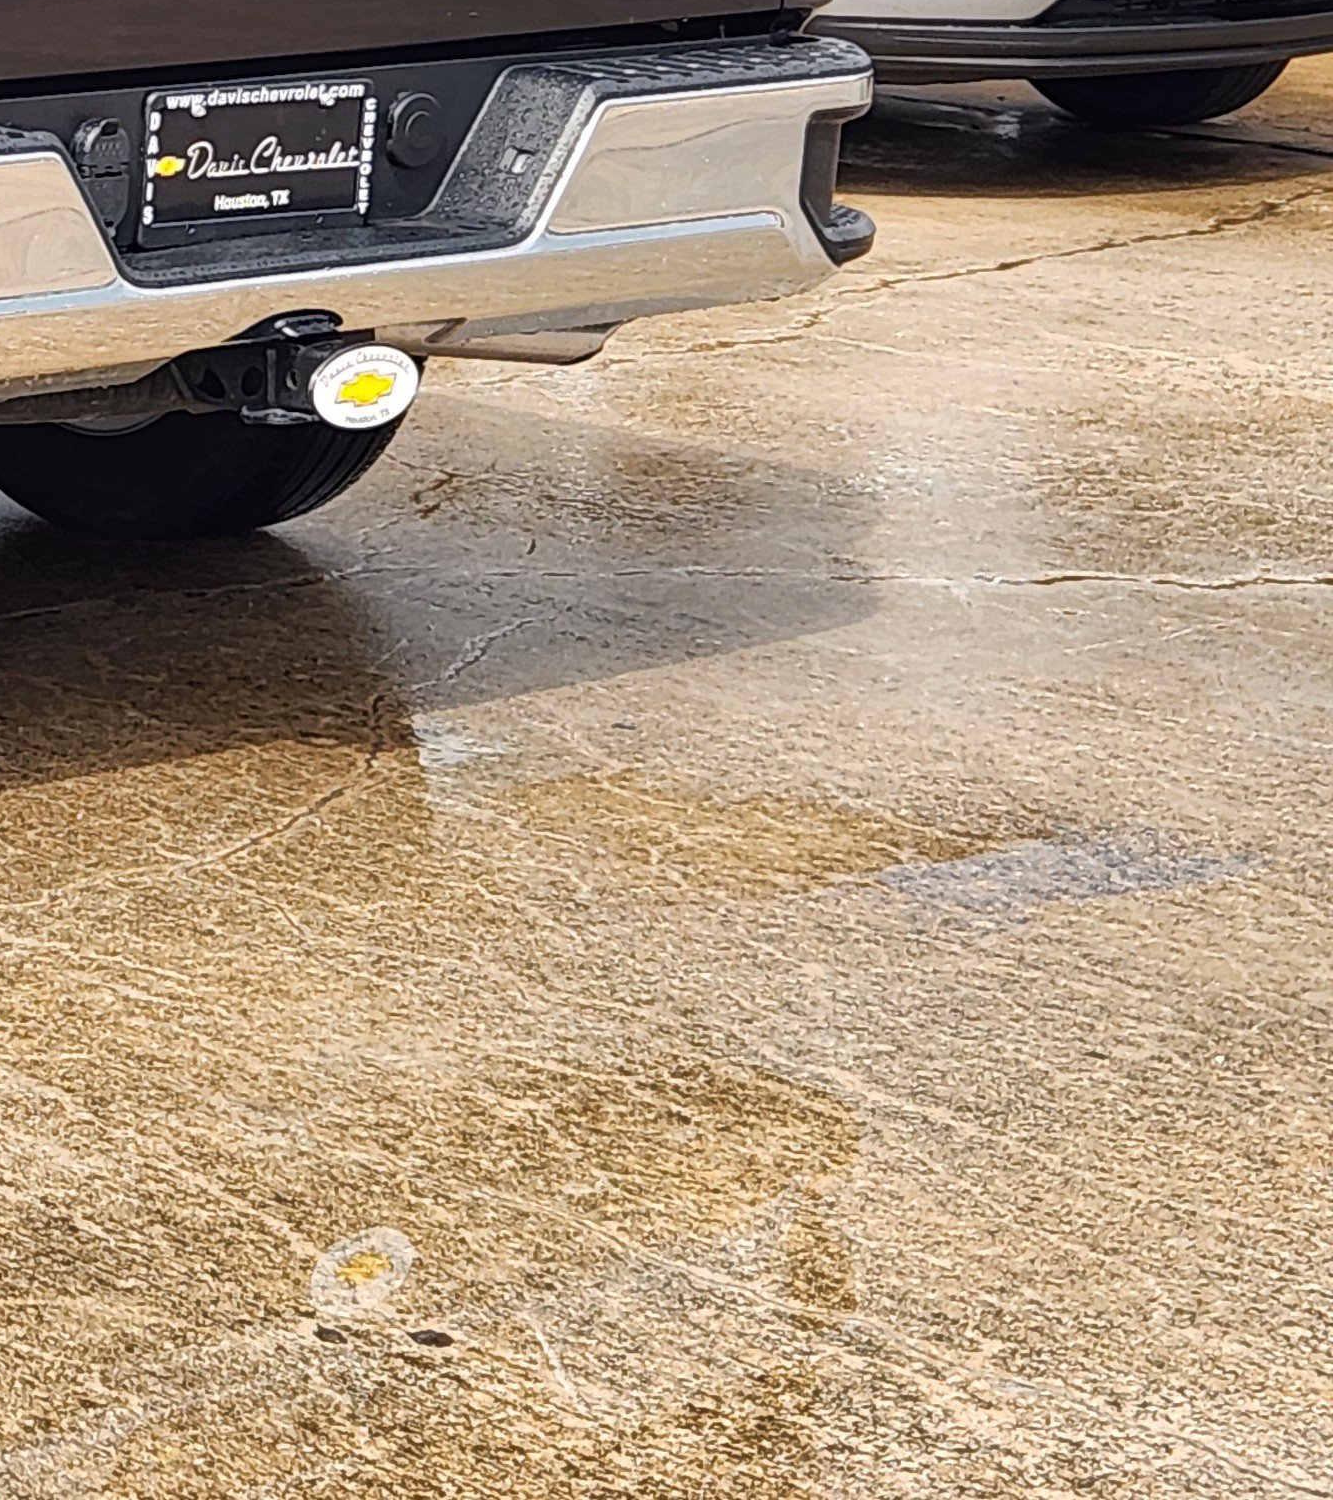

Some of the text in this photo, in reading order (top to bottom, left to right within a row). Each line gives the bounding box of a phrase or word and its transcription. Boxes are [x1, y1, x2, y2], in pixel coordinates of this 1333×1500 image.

[166, 83, 365, 111] www.davischevrolet.com
[142, 111, 162, 225] DAVIS
[186, 135, 361, 180] Davis Chevrolet
[355, 97, 378, 215] CHEVROLET
[271, 189, 291, 207] TX
